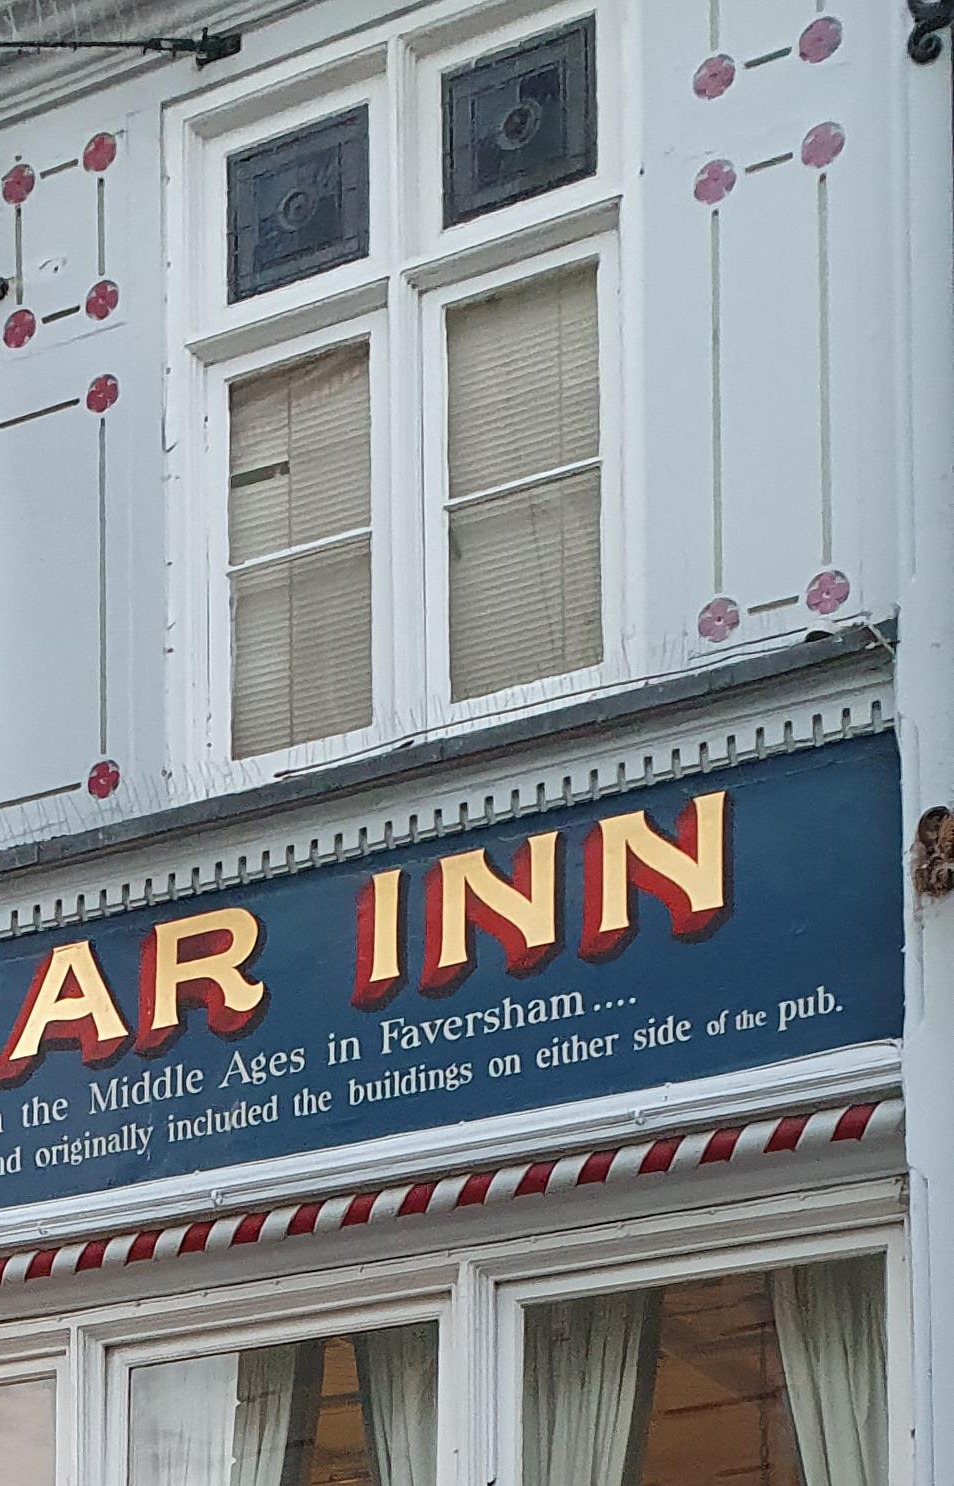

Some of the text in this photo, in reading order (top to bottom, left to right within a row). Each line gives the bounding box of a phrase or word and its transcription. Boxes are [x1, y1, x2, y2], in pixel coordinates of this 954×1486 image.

[352, 791, 732, 1010] INN
[22, 1094, 68, 1129] the
[89, 1065, 204, 1116] Middle
[220, 1042, 306, 1089] Ages
[328, 1033, 361, 1066] in
[35, 1123, 154, 1170] originally
[167, 1098, 279, 1141] included
[293, 1086, 333, 1117] the
[348, 1060, 474, 1105] buildings
[488, 1051, 523, 1077] on
[536, 1031, 621, 1069] either
[633, 1016, 692, 1052] side
[707, 1009, 728, 1036] of
[735, 1008, 767, 1031] the
[778, 986, 845, 1033] pub.
